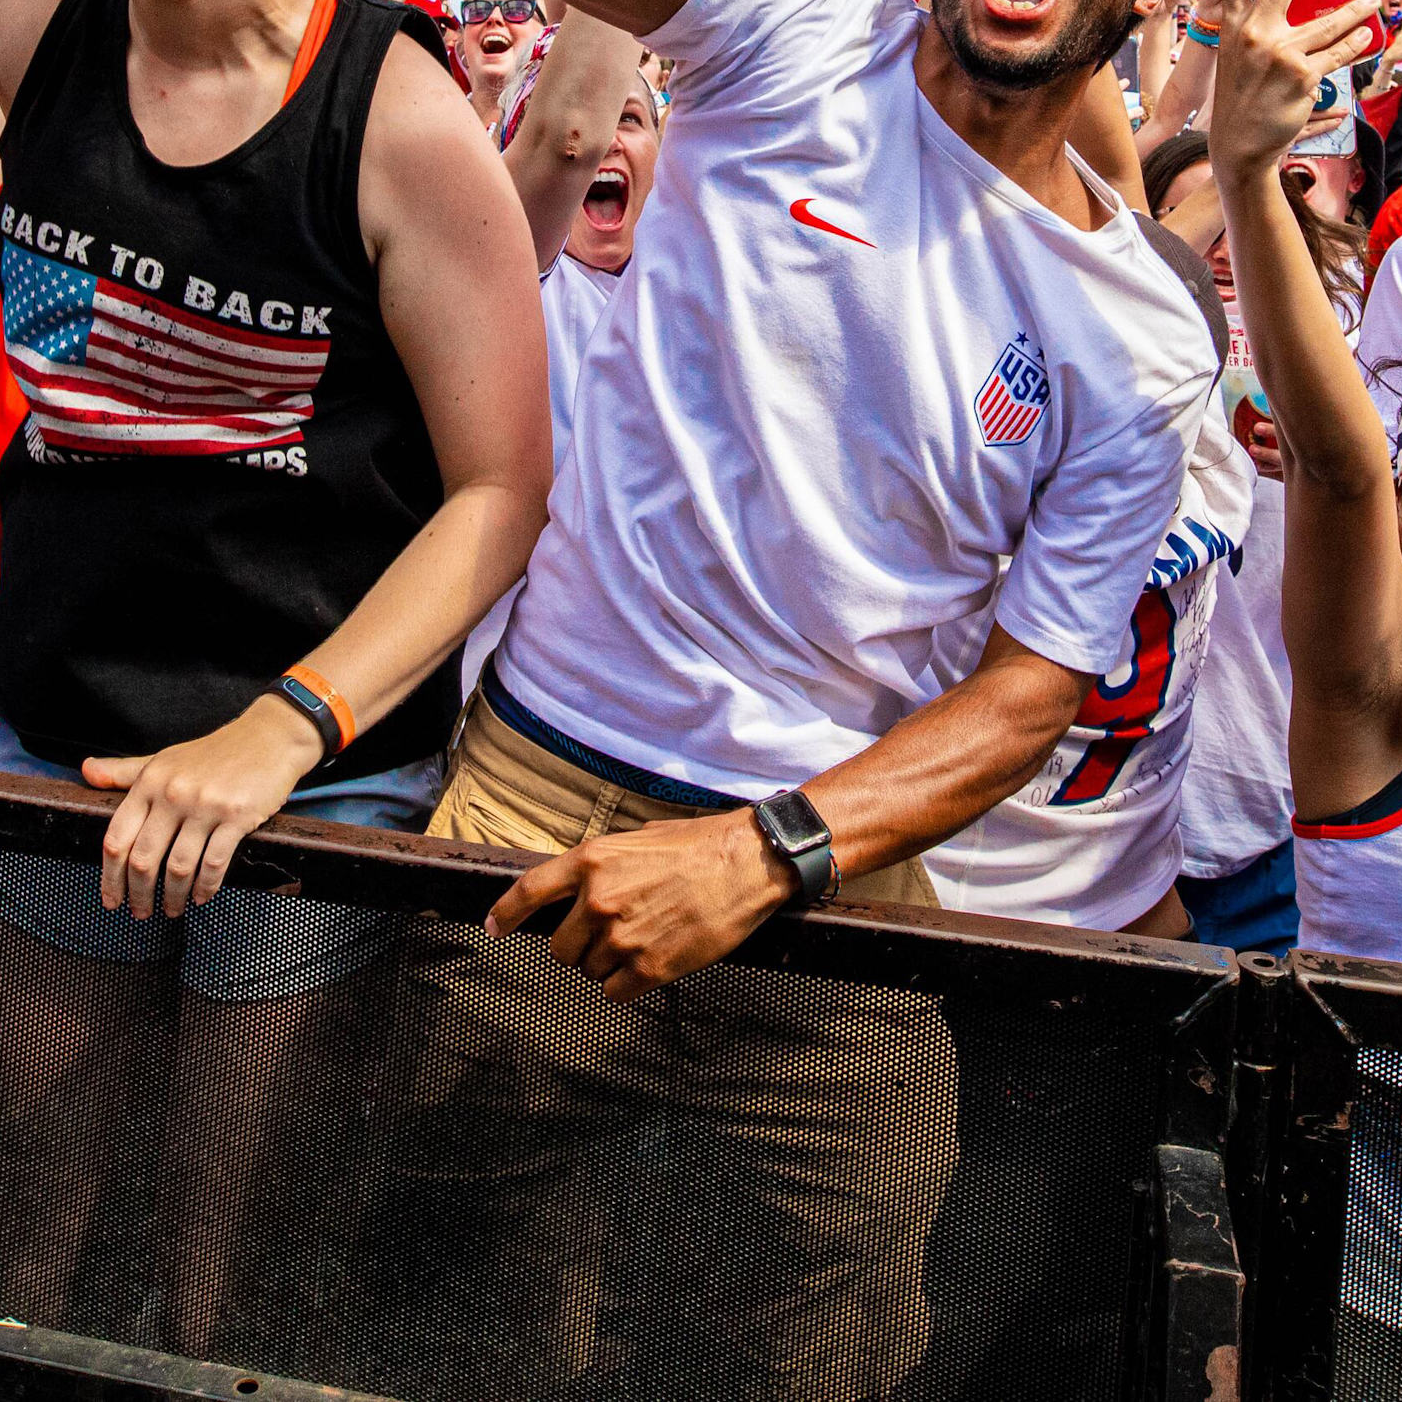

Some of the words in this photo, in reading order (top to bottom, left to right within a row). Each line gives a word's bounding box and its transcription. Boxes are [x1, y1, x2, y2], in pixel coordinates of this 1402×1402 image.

[1, 203, 95, 265] BACK
[110, 243, 165, 291] TO
[184, 275, 333, 335] BACK
[1000, 351, 1051, 405] USA
